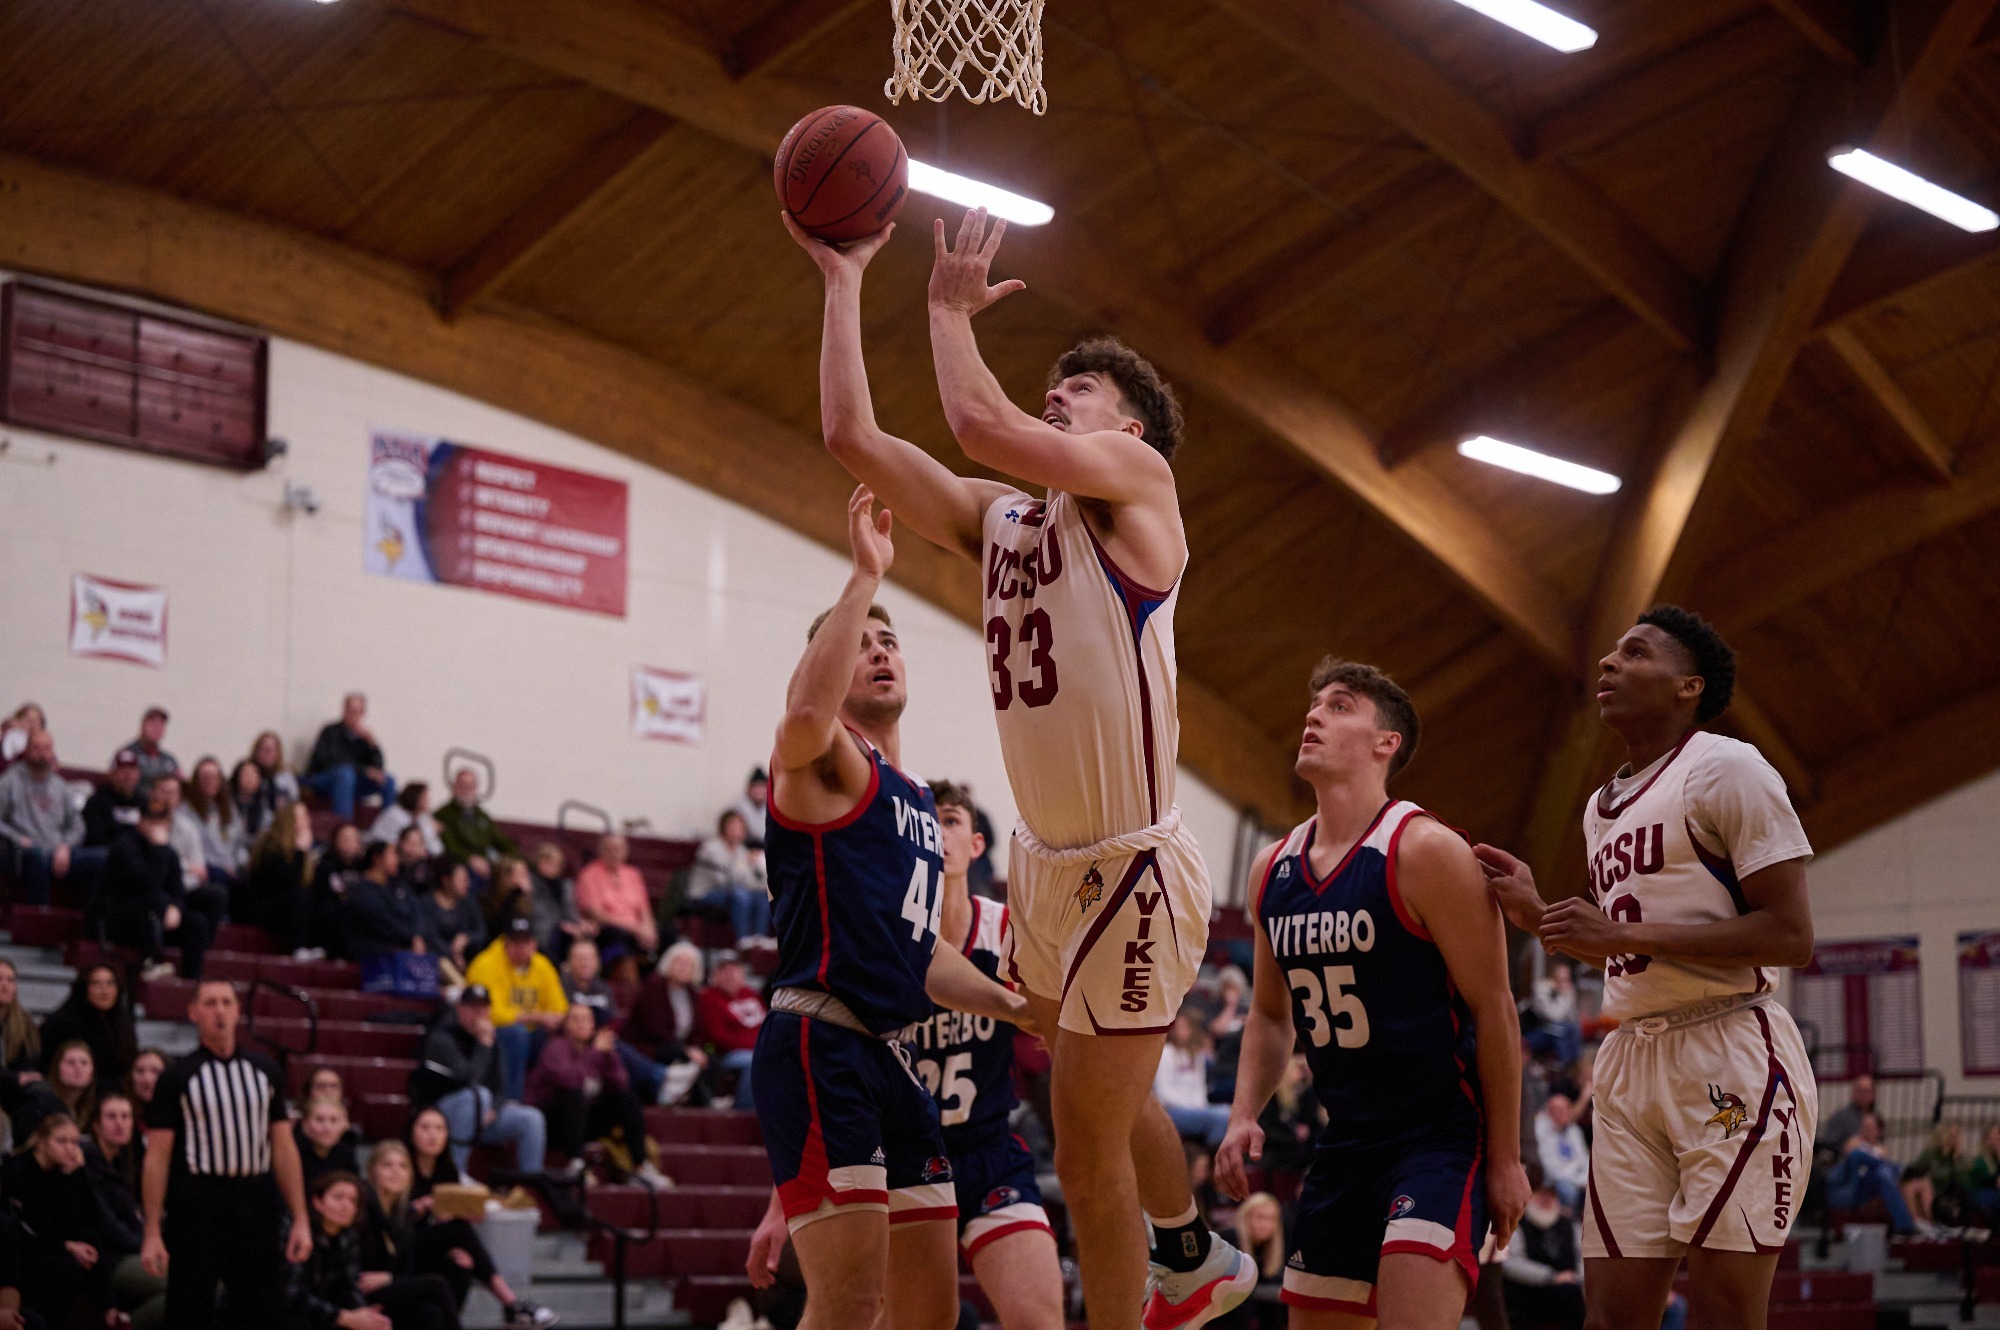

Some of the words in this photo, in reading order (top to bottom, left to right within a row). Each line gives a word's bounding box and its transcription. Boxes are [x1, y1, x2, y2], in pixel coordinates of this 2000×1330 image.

[987, 523, 1062, 600] VCSU
[987, 607, 1059, 711] 33
[1120, 892, 1161, 1012] VIKES
[1268, 909, 1375, 958] VITERBO
[1287, 965, 1370, 1049] 35
[1772, 1108, 1794, 1229] VIKES
